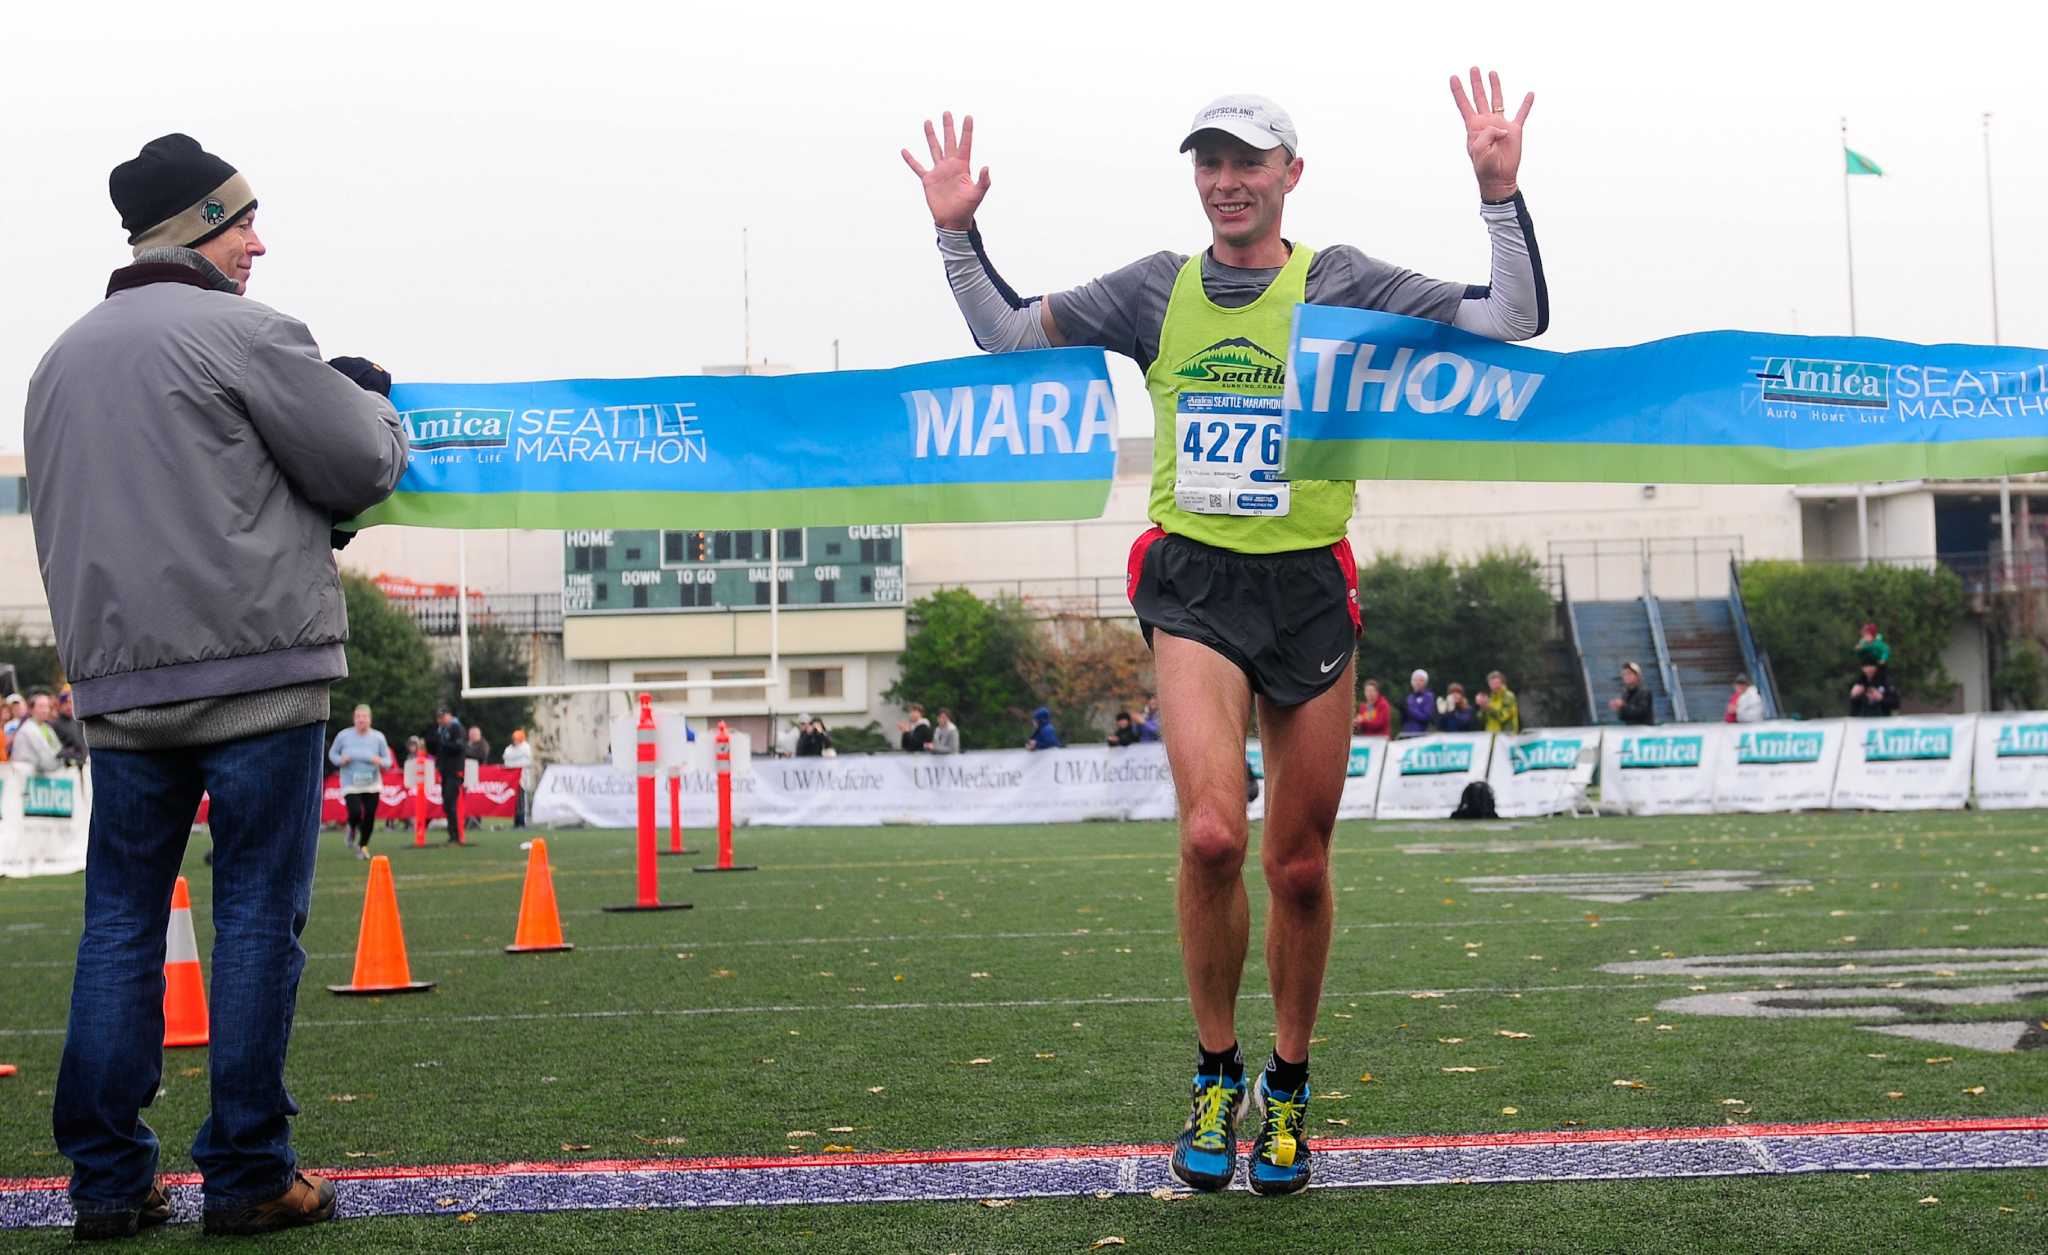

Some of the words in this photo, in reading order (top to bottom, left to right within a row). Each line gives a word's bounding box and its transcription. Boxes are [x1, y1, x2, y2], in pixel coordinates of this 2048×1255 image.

[1765, 358, 1881, 398] Amica
[1213, 396, 1242, 408] SEATTLE
[1243, 397, 1281, 410] MARATHON
[1899, 396, 2048, 423] MARATH
[517, 402, 704, 438] SEATTLE
[515, 436, 707, 464] MARATHON
[1183, 421, 1280, 466] 4276
[566, 530, 615, 547] HOME
[848, 525, 900, 540] GUEST
[567, 574, 594, 587] TIME
[621, 570, 661, 586] DOWN
[676, 569, 693, 585] TO
[697, 569, 717, 584] GO
[814, 565, 841, 581] QTR
[874, 566, 901, 578] TIME
[565, 598, 593, 610] LEFT
[874, 590, 902, 602] LEFT
[1619, 737, 1698, 764] Amica
[1739, 732, 1819, 758] Amica
[1866, 729, 1948, 756] Amica
[1401, 747, 1469, 769] Amica
[813, 767, 884, 791] Medicine
[948, 765, 1024, 789] Medicine
[1089, 758, 1169, 785] Medicine
